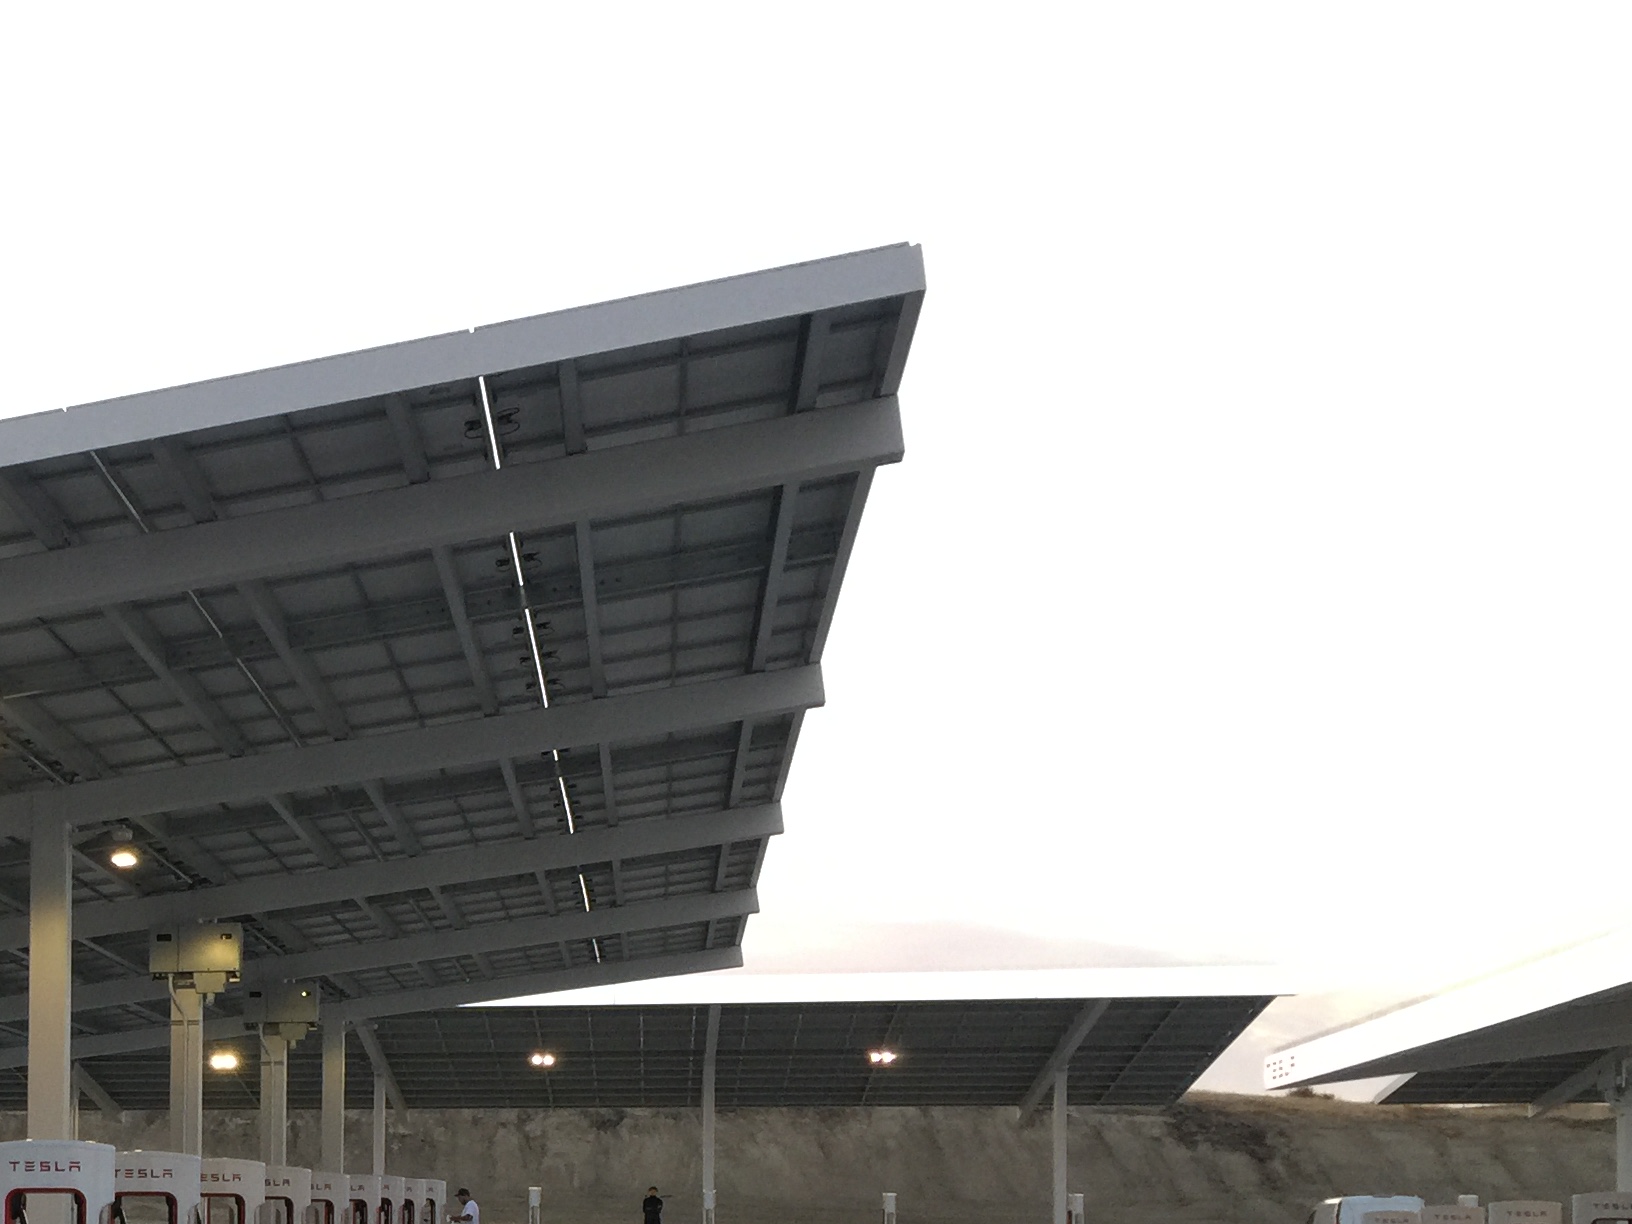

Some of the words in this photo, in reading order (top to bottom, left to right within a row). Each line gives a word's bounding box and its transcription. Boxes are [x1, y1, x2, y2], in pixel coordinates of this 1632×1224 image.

[8, 1160, 82, 1173] TESLA
[200, 1172, 242, 1183] ESLA
[1592, 1202, 1632, 1211] TESL
